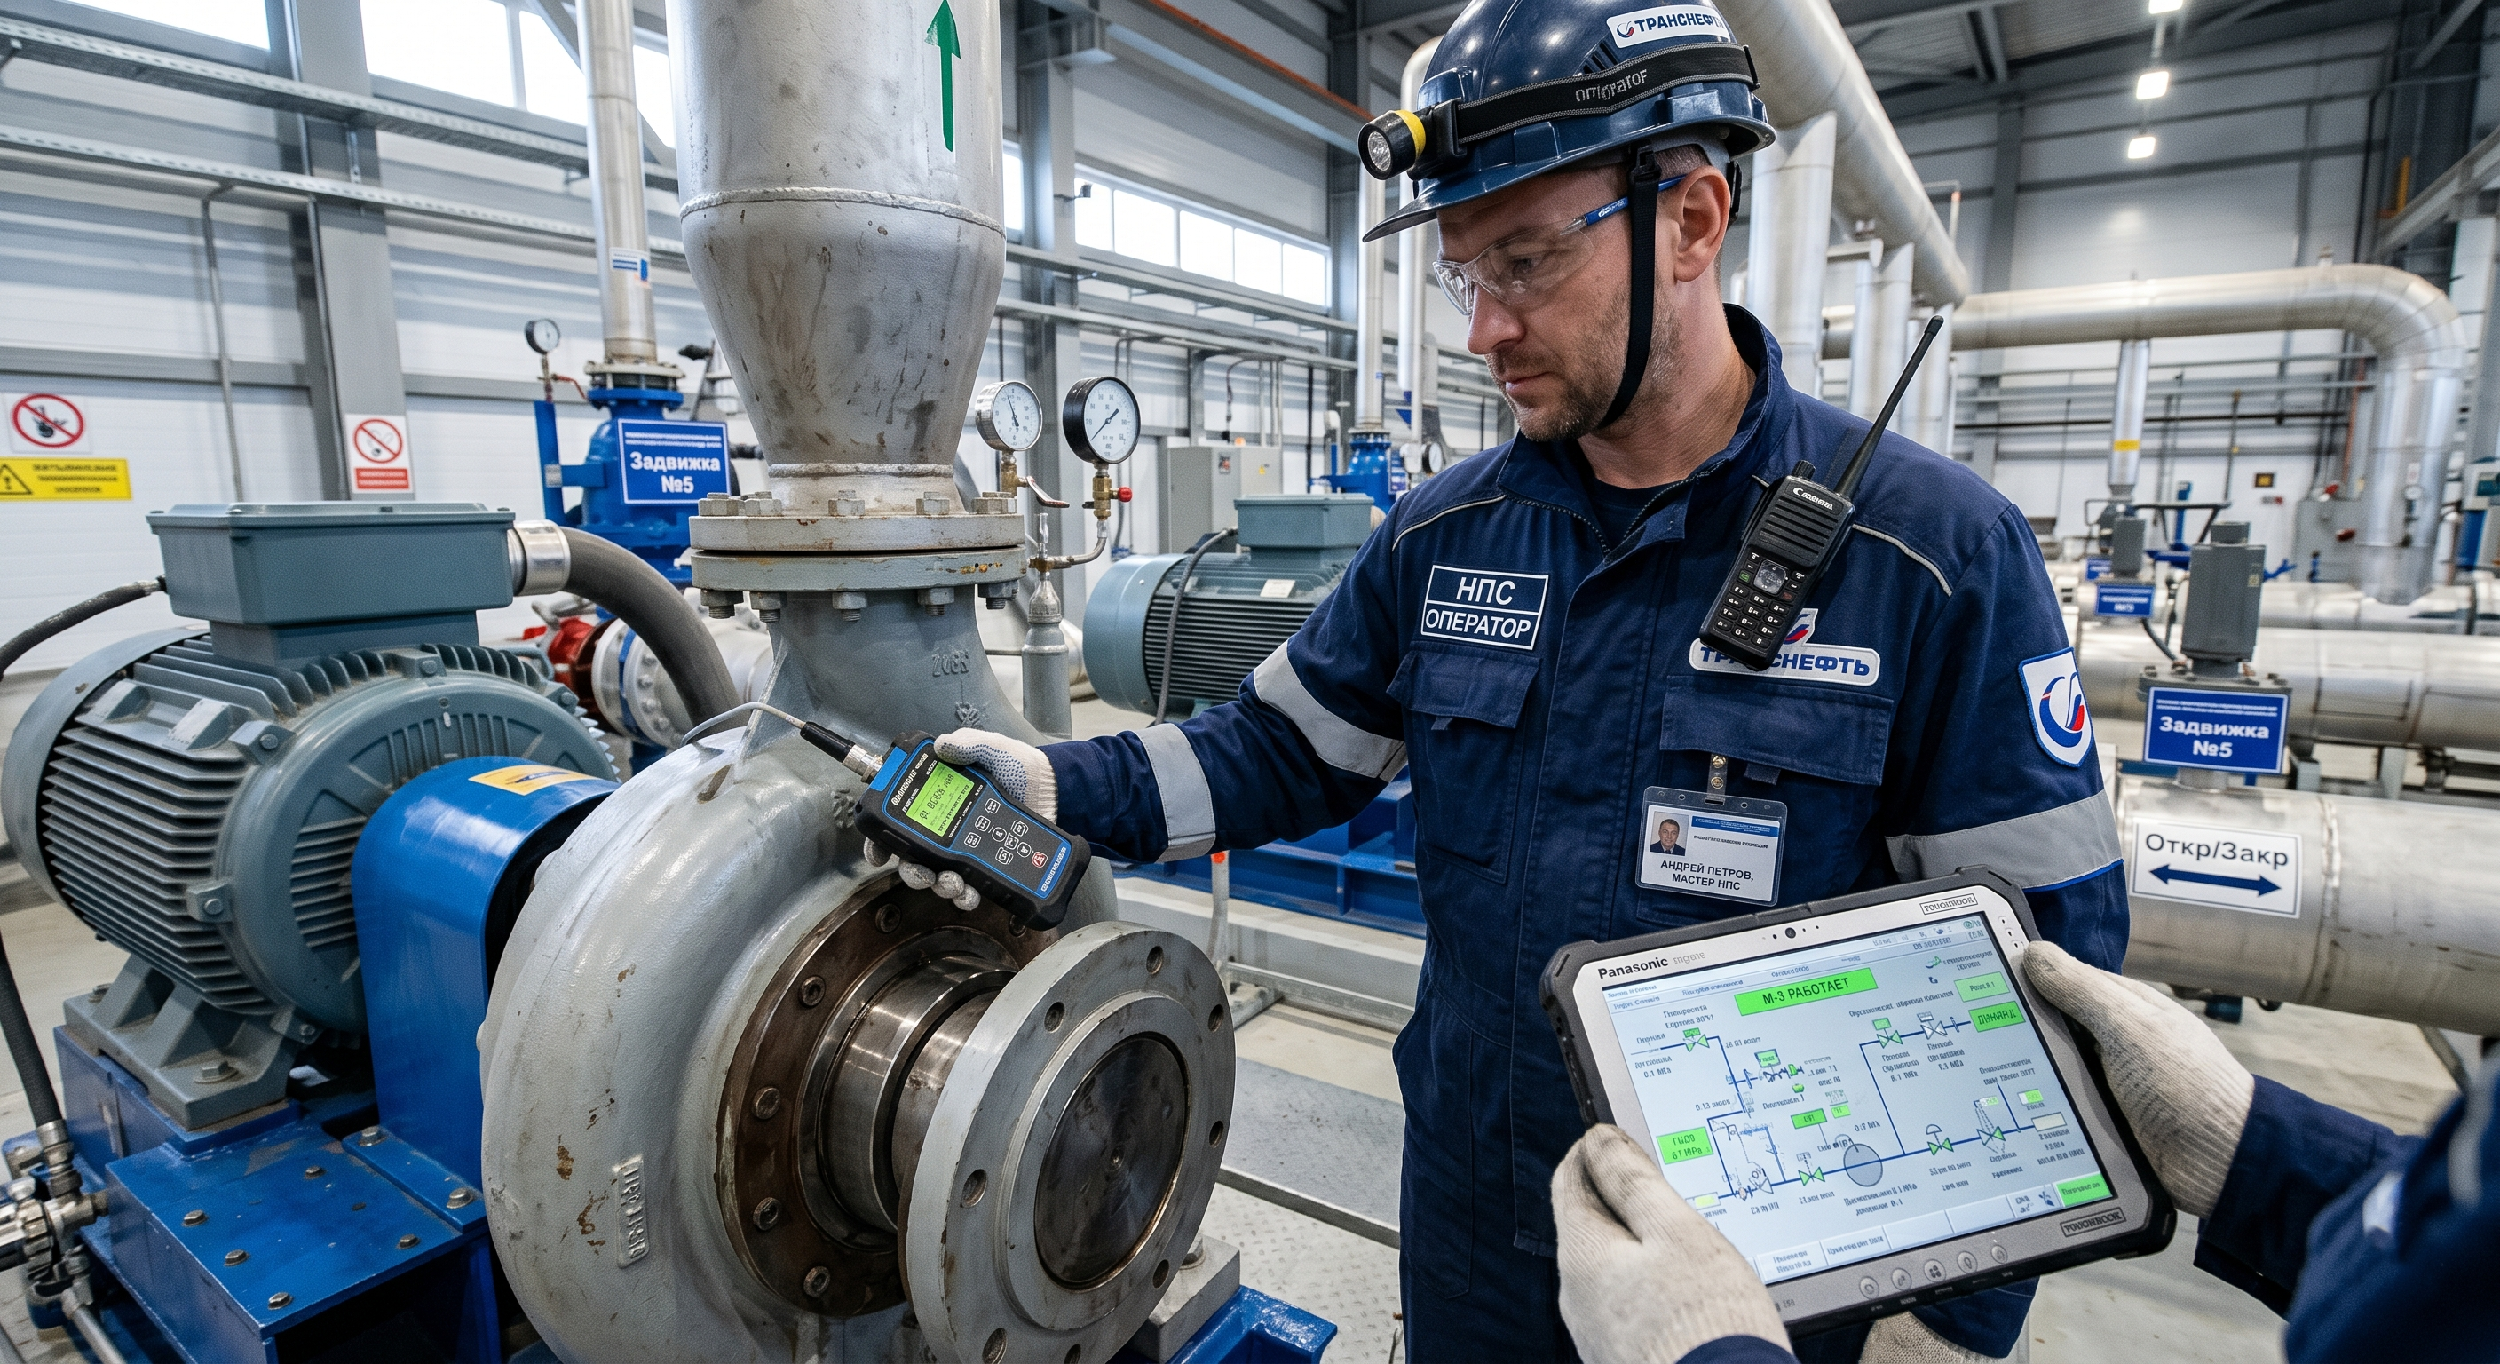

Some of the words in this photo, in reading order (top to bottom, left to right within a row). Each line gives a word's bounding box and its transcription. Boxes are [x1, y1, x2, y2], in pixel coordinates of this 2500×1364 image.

[629, 450, 721, 472] Задвижка
[660, 475, 694, 494] №5
[1456, 576, 1516, 606] НПС
[1425, 608, 1532, 639] ОПЕРАТОР
[1700, 646, 1870, 677] ТРСНЕФТЬ
[2159, 716, 2270, 739] Задвижка
[2193, 740, 2233, 758] №5
[2145, 833, 2289, 870] Откр/Закр
[1660, 860, 1705, 874] АНДРЕЙ
[1672, 873, 1715, 887] МАСТЕР
[1718, 880, 1741, 891] НПС
[1598, 956, 1668, 979] Panasonic
[1763, 993, 1785, 1004] М-3
[1788, 977, 1849, 1000] РАБОТАЕТ
